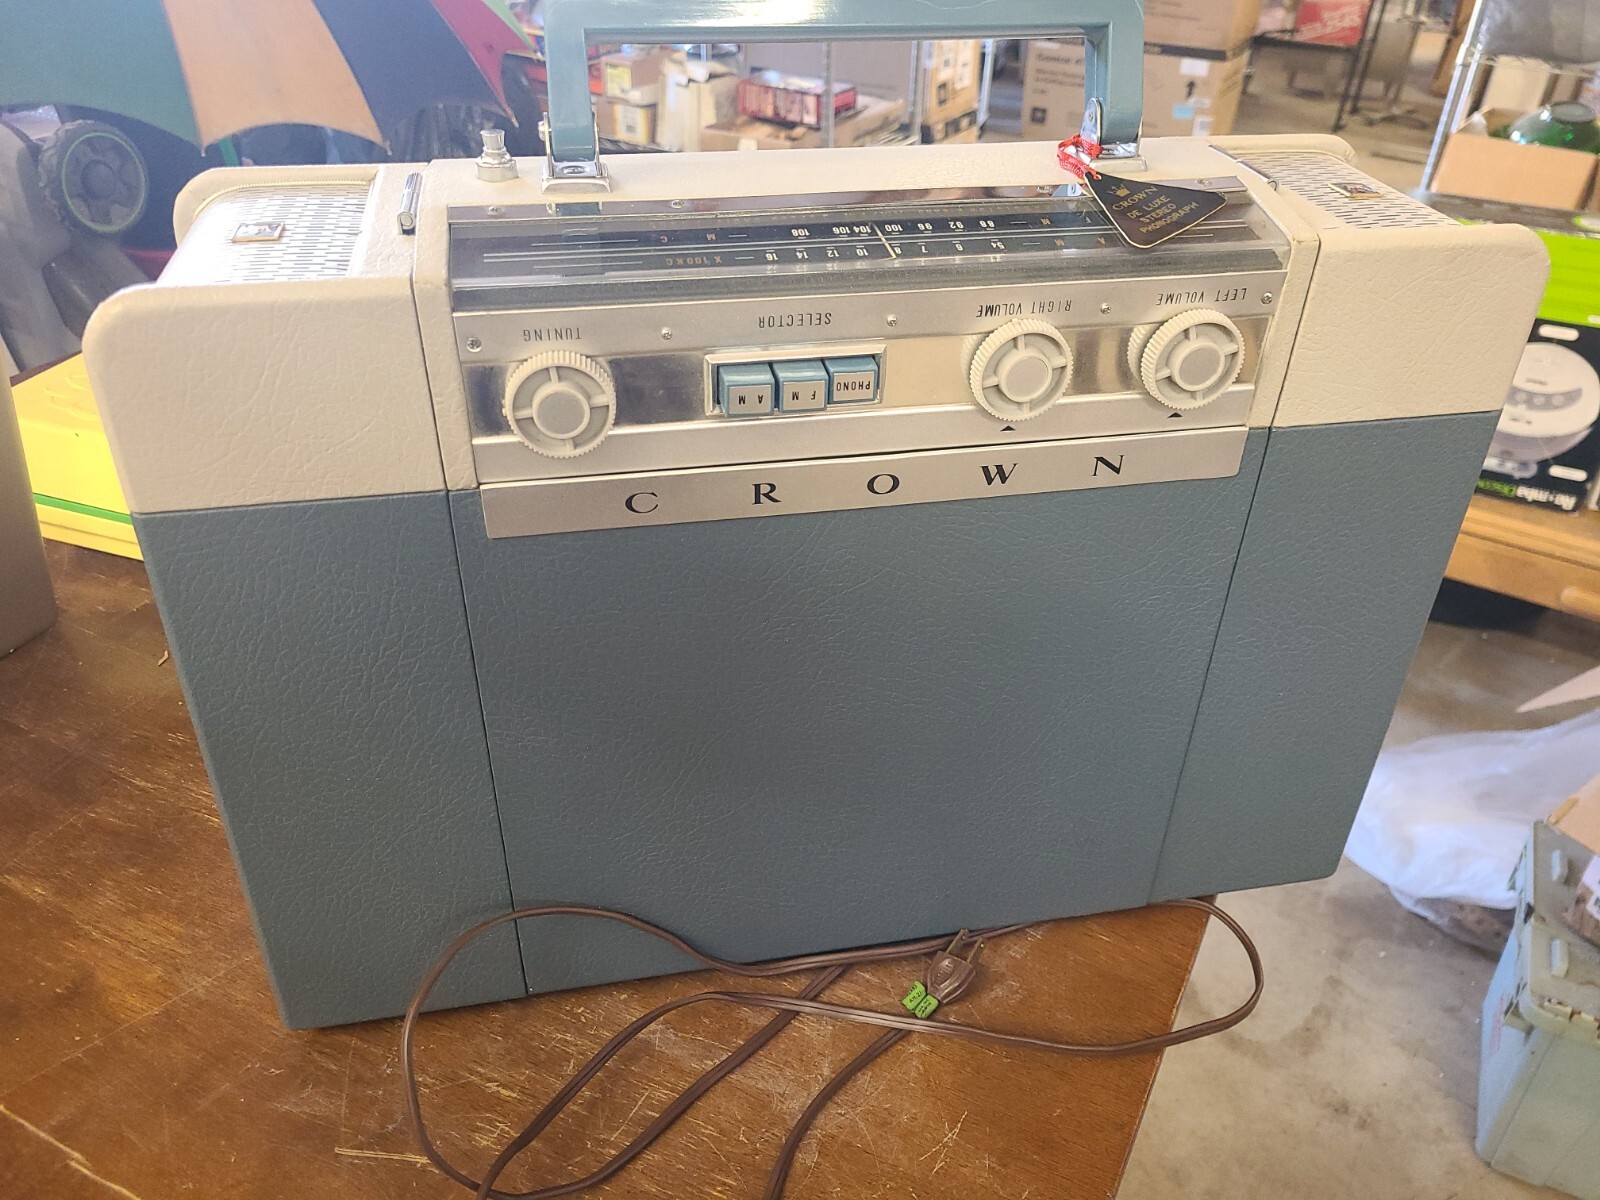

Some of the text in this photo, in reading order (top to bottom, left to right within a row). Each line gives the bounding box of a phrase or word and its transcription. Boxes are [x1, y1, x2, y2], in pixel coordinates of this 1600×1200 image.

[1112, 186, 1158, 211] CROWN
[1127, 195, 1170, 219] DE LUXE
[1140, 203, 1177, 223] STEREO
[1140, 202, 1199, 233] PHONOGRAPH
[885, 224, 903, 232] 100
[918, 223, 933, 231] 96
[949, 221, 964, 229] 92
[979, 220, 995, 228] 88
[791, 228, 810, 237] 108
[832, 226, 850, 235] 106
[853, 225, 871, 233] 104
[921, 245, 929, 253] 7
[955, 244, 964, 252] 6
[991, 242, 1005, 250] 54
[796, 251, 809, 259] 14
[826, 250, 840, 258] 12
[856, 248, 869, 257] 10
[894, 247, 902, 255] 8
[766, 252, 778, 261] 16
[1155, 287, 1247, 306] LEFT VOLUME
[976, 299, 1072, 318] RIGHT VOLUME
[758, 312, 832, 329] SELECTOR
[523, 327, 582, 342] TUNING
[836, 380, 871, 392] PHONO
